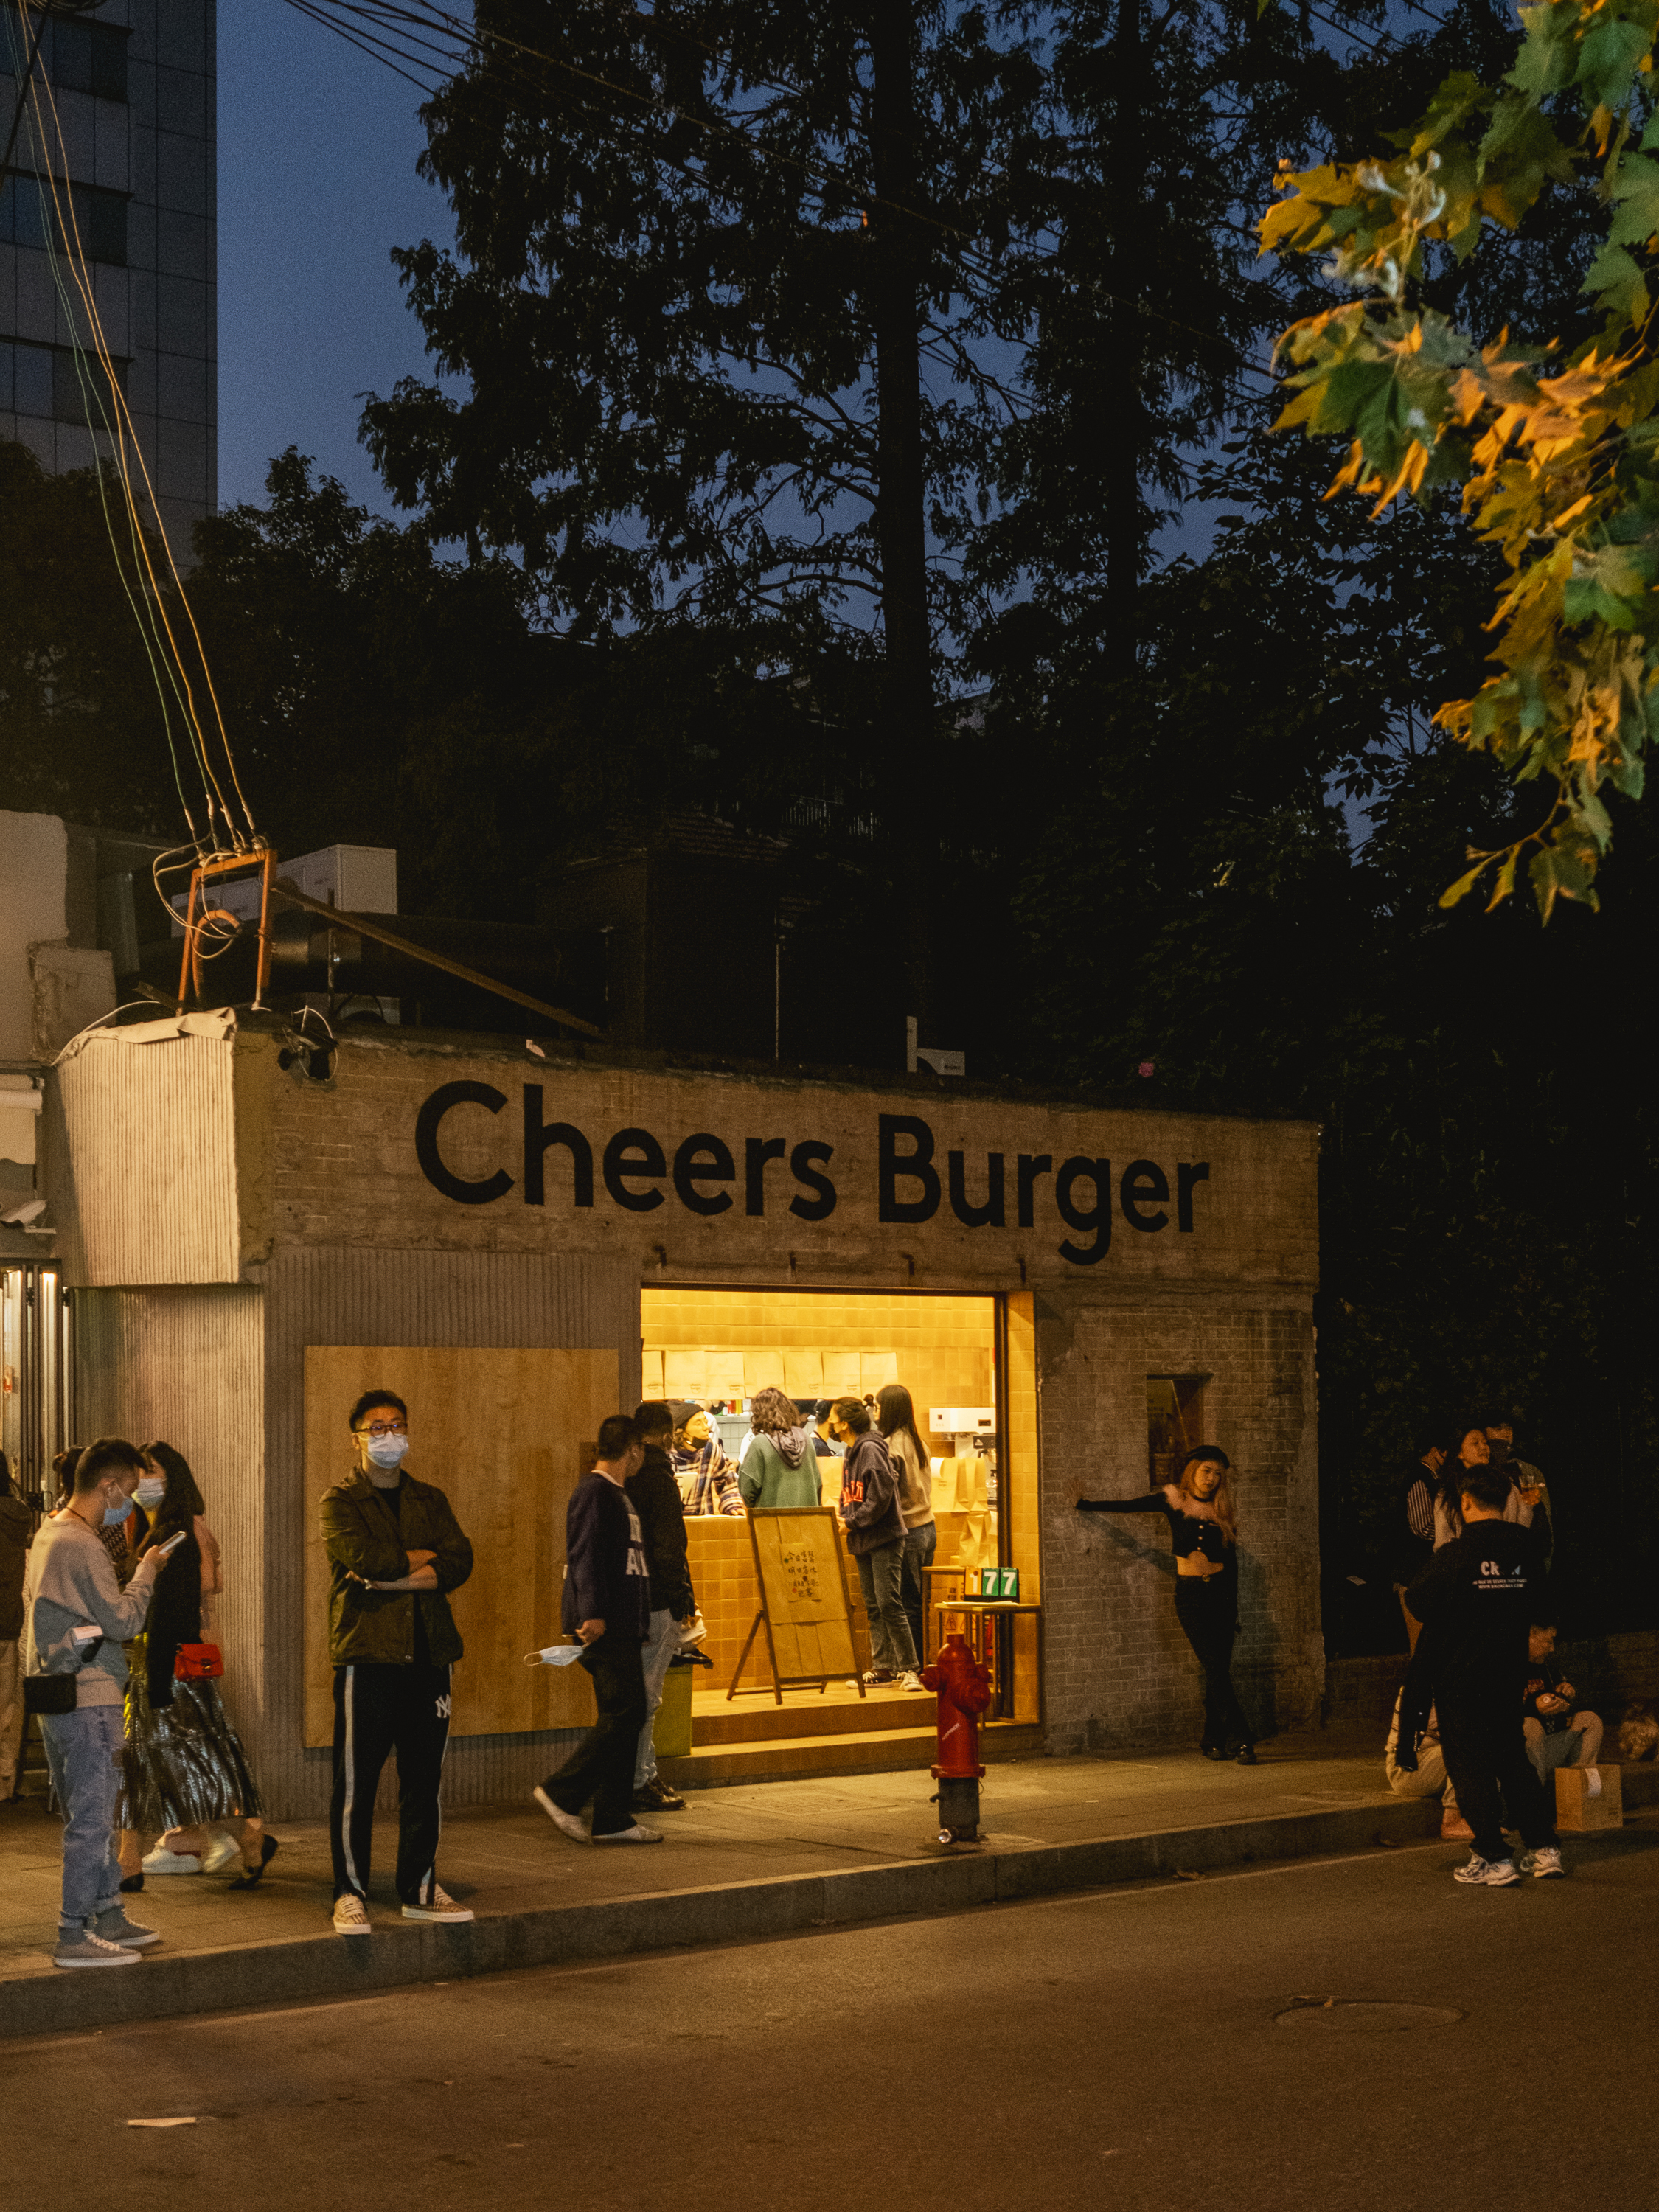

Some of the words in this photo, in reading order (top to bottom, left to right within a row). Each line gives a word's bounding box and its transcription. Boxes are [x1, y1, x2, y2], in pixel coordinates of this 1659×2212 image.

[415, 1079, 838, 1221] Cheers
[878, 1113, 1210, 1266] Burger
[969, 1571, 1017, 1596] 177
